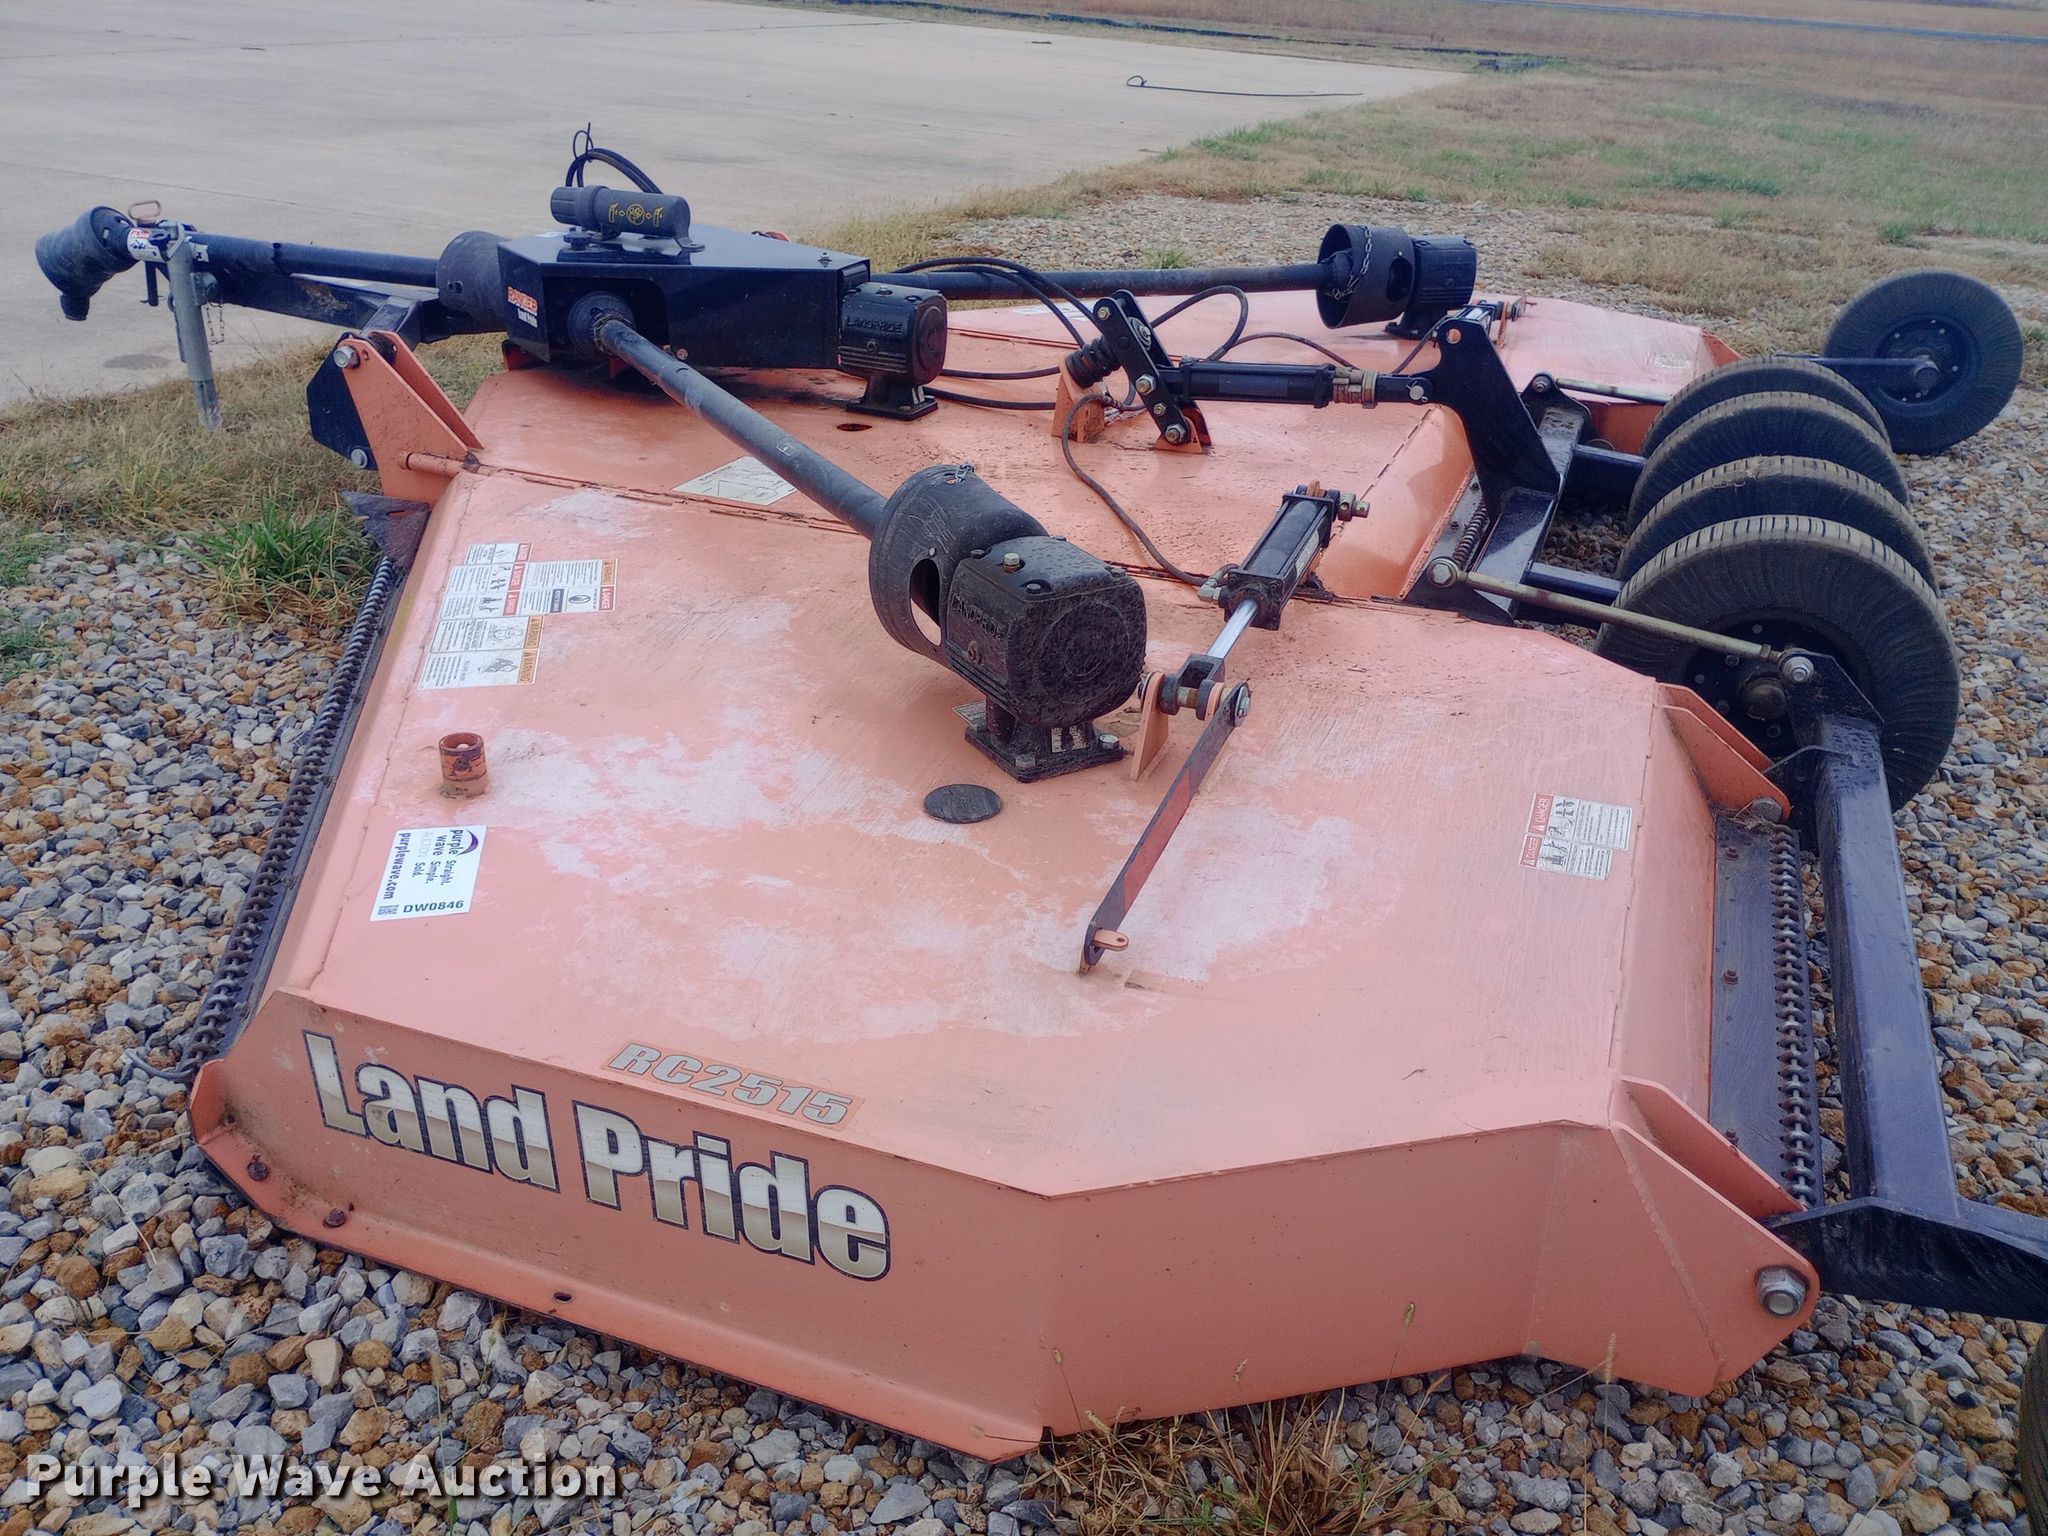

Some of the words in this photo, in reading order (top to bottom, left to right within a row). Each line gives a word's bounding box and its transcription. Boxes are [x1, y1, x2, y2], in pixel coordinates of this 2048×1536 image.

[433, 835, 447, 856] wave
[447, 829, 464, 855] purple
[383, 832, 412, 899] purplewave.com
[412, 862, 426, 878] Sold.
[425, 860, 441, 884] Simple.
[403, 900, 464, 913] DW0846
[606, 1041, 854, 1126] RC2515
[302, 1029, 561, 1193] Land
[572, 1099, 892, 1282] Pride
